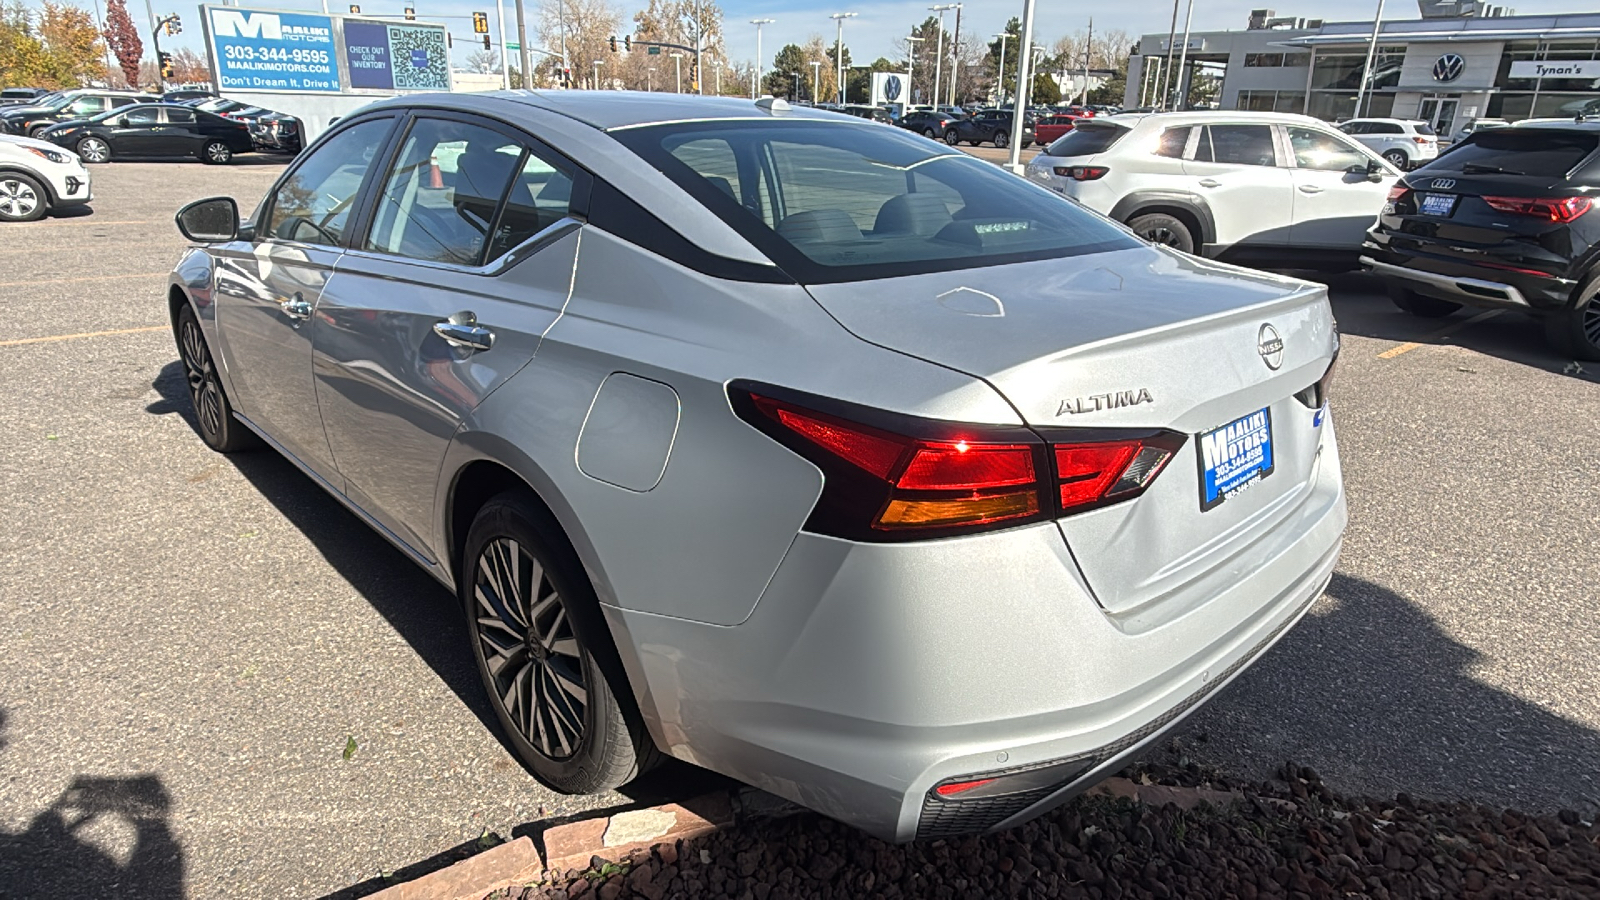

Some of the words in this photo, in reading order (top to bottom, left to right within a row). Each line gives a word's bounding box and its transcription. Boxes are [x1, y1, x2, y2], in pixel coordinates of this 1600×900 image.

[211, 10, 329, 40] MAALIKI
[282, 33, 330, 43] MOTORS
[224, 45, 329, 64] 303-344-9595
[349, 45, 370, 54] CHECK
[371, 46, 384, 55] OUT
[227, 60, 330, 74] MAALIKIMOTORS.COM
[351, 60, 386, 69] INVENTORY
[1536, 64, 1582, 77] Tynan's
[222, 75, 251, 86] Don't
[253, 77, 288, 88] Dream
[303, 79, 329, 89] Drive
[332, 80, 339, 89] It
[1055, 388, 1154, 417] ALTIMA
[1214, 445, 1263, 479] 303-344-9595
